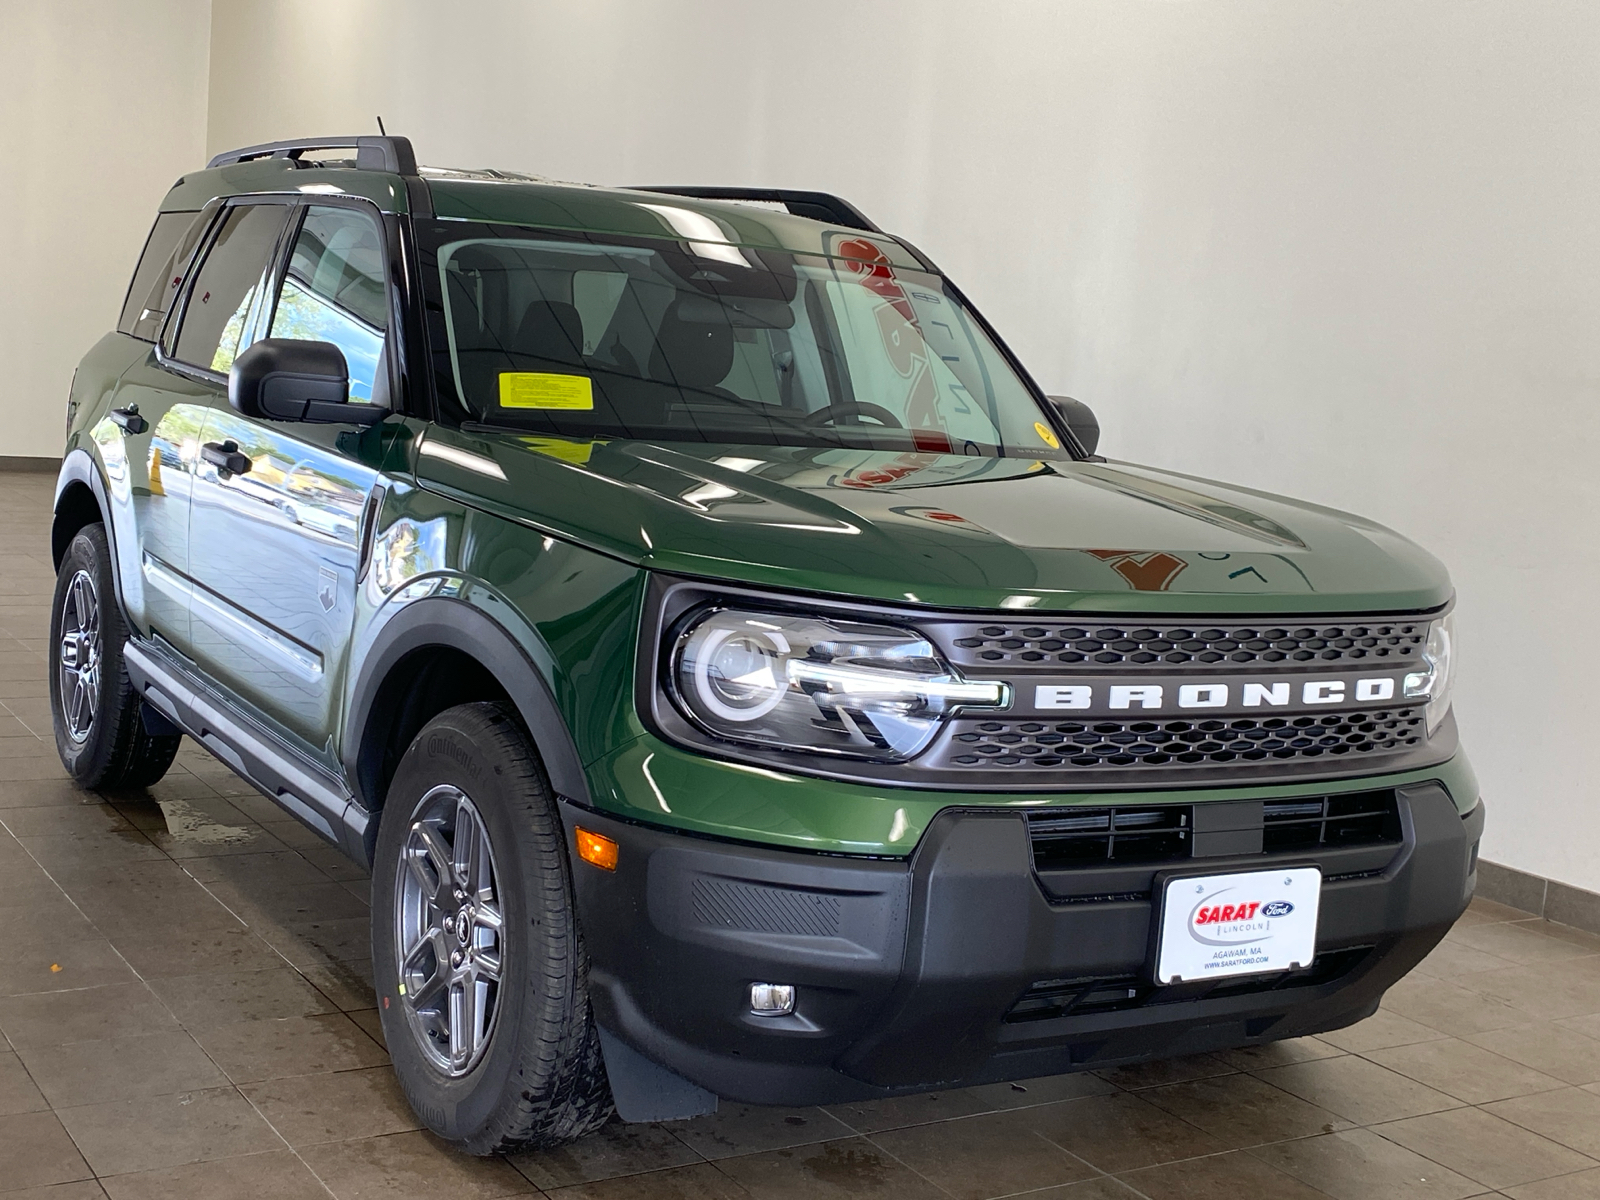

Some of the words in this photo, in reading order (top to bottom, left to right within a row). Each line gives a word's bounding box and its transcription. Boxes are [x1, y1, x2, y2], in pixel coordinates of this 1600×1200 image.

[1034, 677, 1395, 710] BRONCO
[1195, 901, 1262, 925] SARAT
[1224, 923, 1263, 934] LINCOLN
[1213, 948, 1248, 960] AGAWAM,
[1250, 946, 1262, 956] MA
[1204, 956, 1269, 969] WWW.SARATFORD.COM
